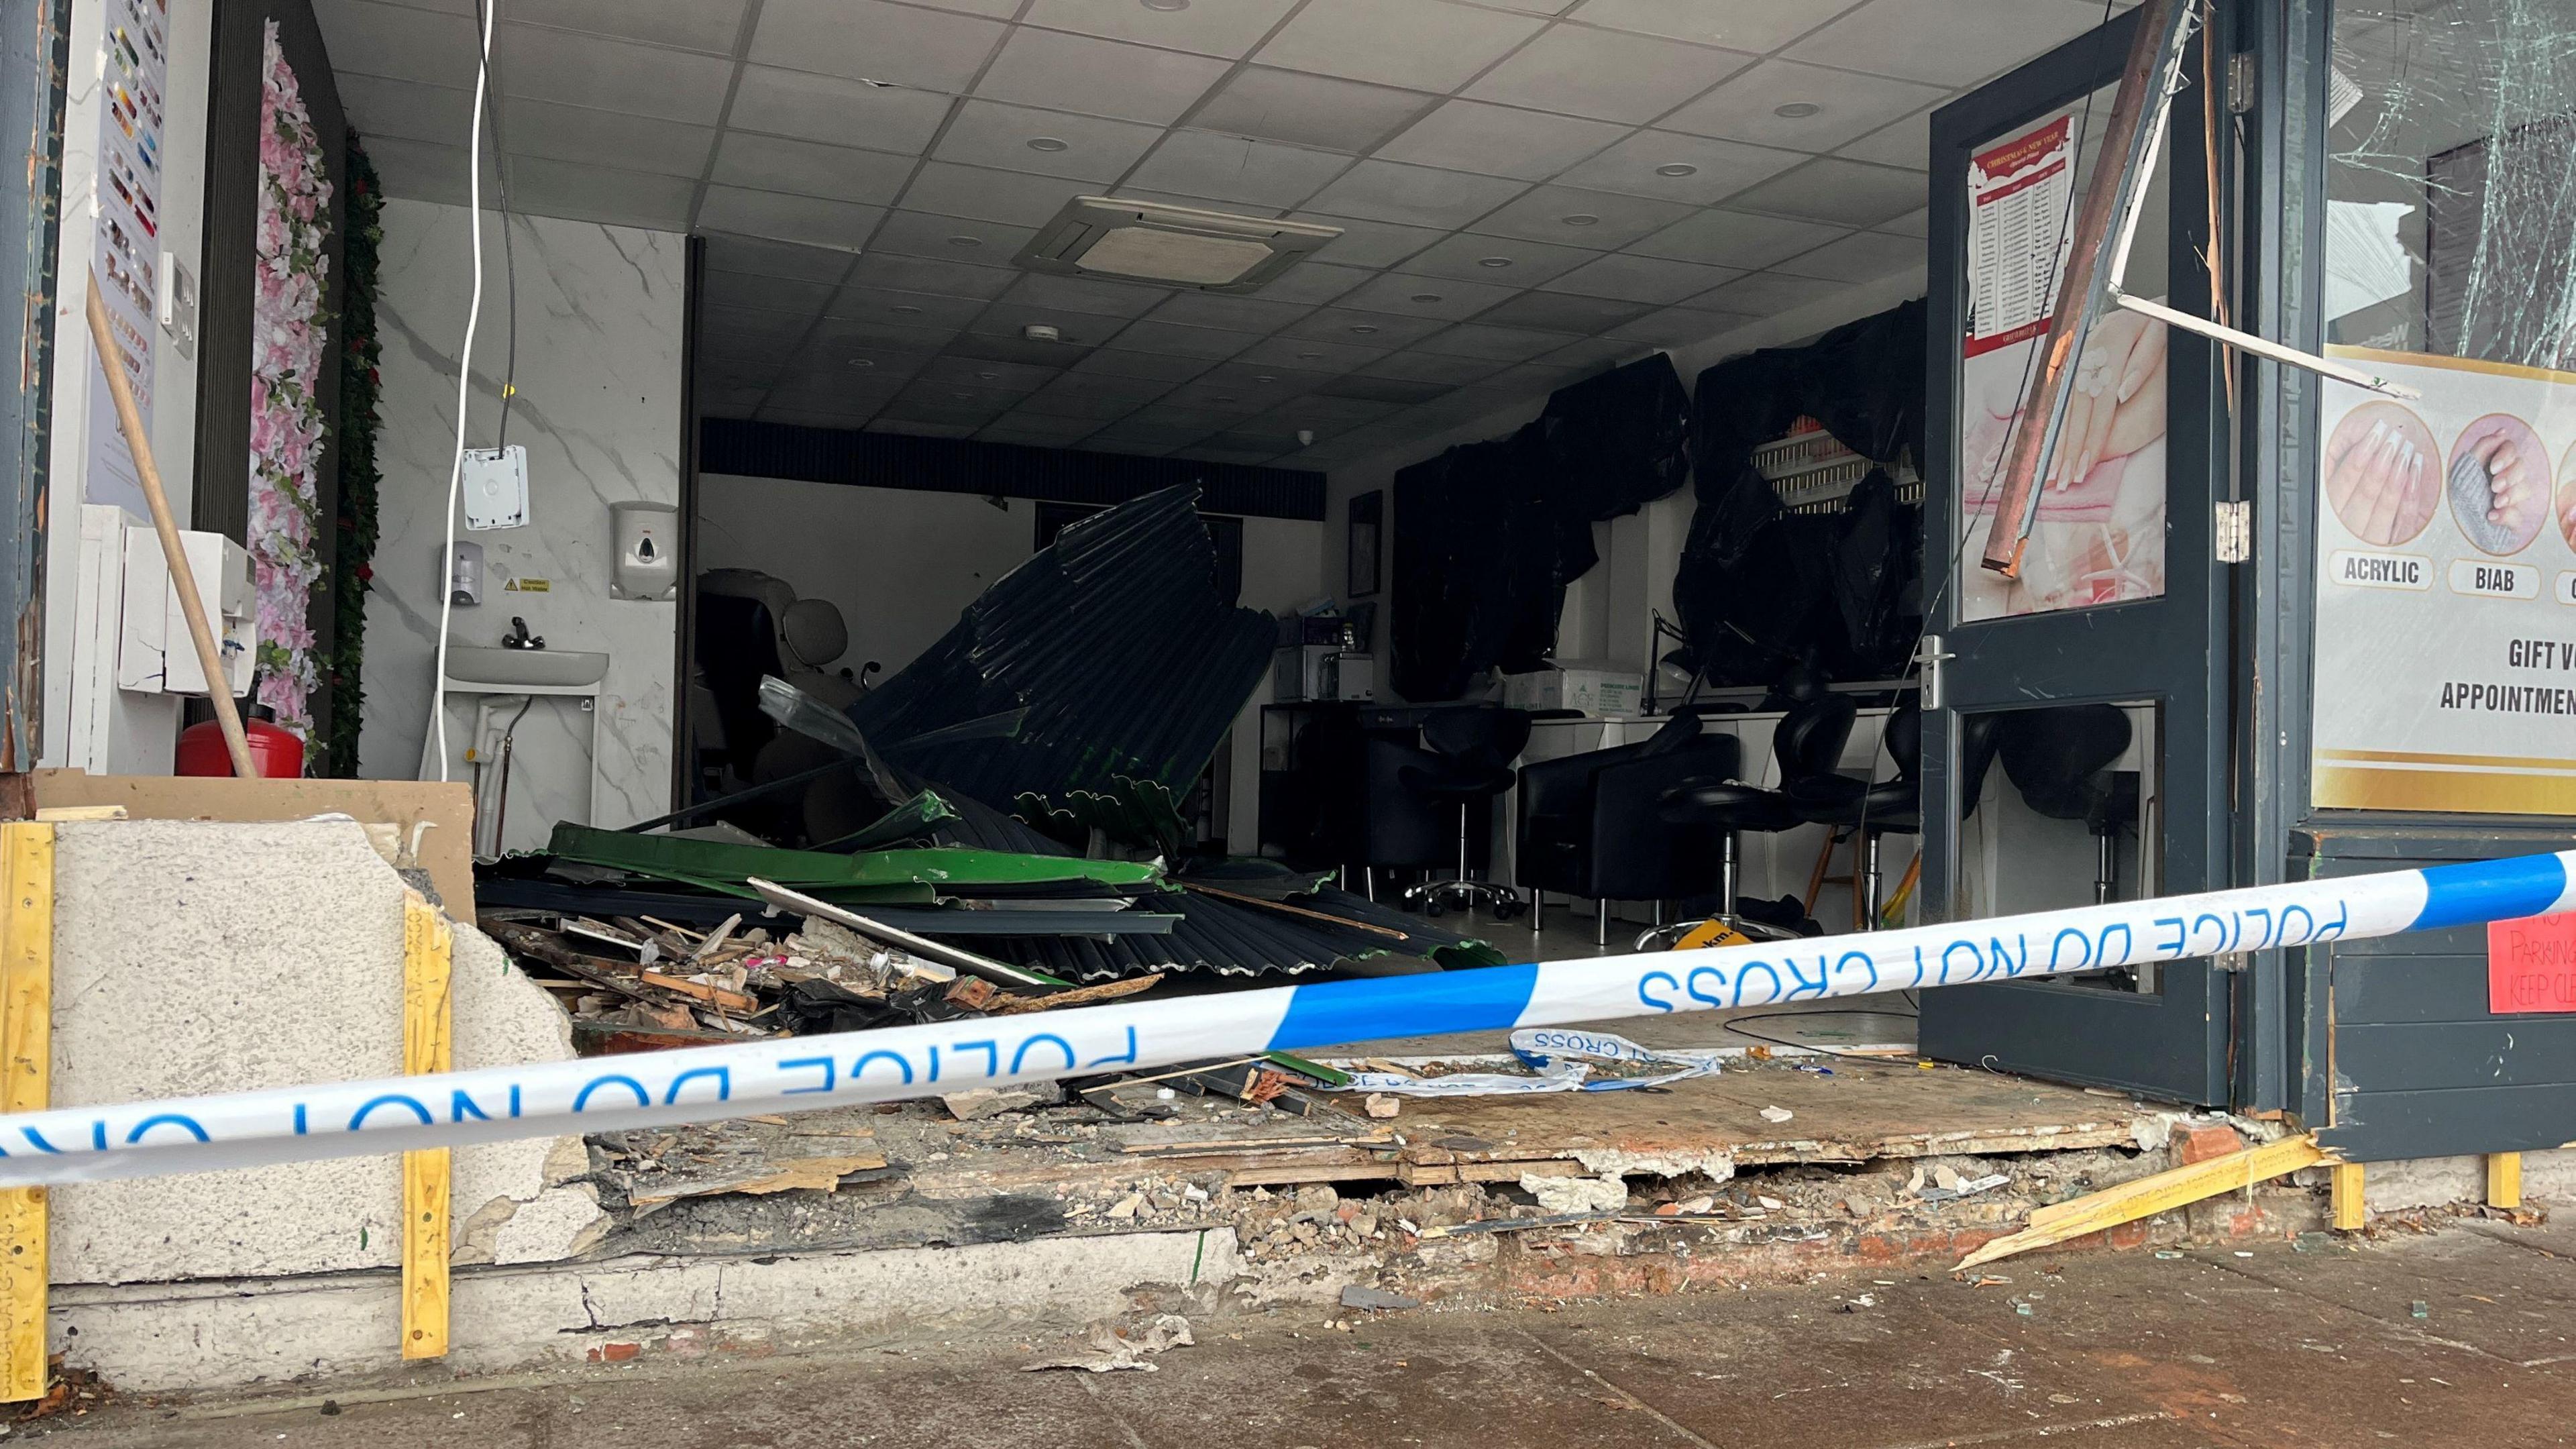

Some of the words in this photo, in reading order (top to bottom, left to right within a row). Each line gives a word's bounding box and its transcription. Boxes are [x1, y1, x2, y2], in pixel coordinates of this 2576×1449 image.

[2344, 557, 2419, 584] ACRYLIC
[2475, 567, 2514, 592] BIAB
[2508, 639, 2555, 669] GIFT
[2561, 643, 2576, 671] V
[2155, 900, 2347, 958] POLICE
[2047, 922, 2132, 972] DO
[1638, 951, 1878, 1012] CROSS
[2510, 974, 2549, 1006] KEEP
[1534, 1032, 1618, 1057] CROSS
